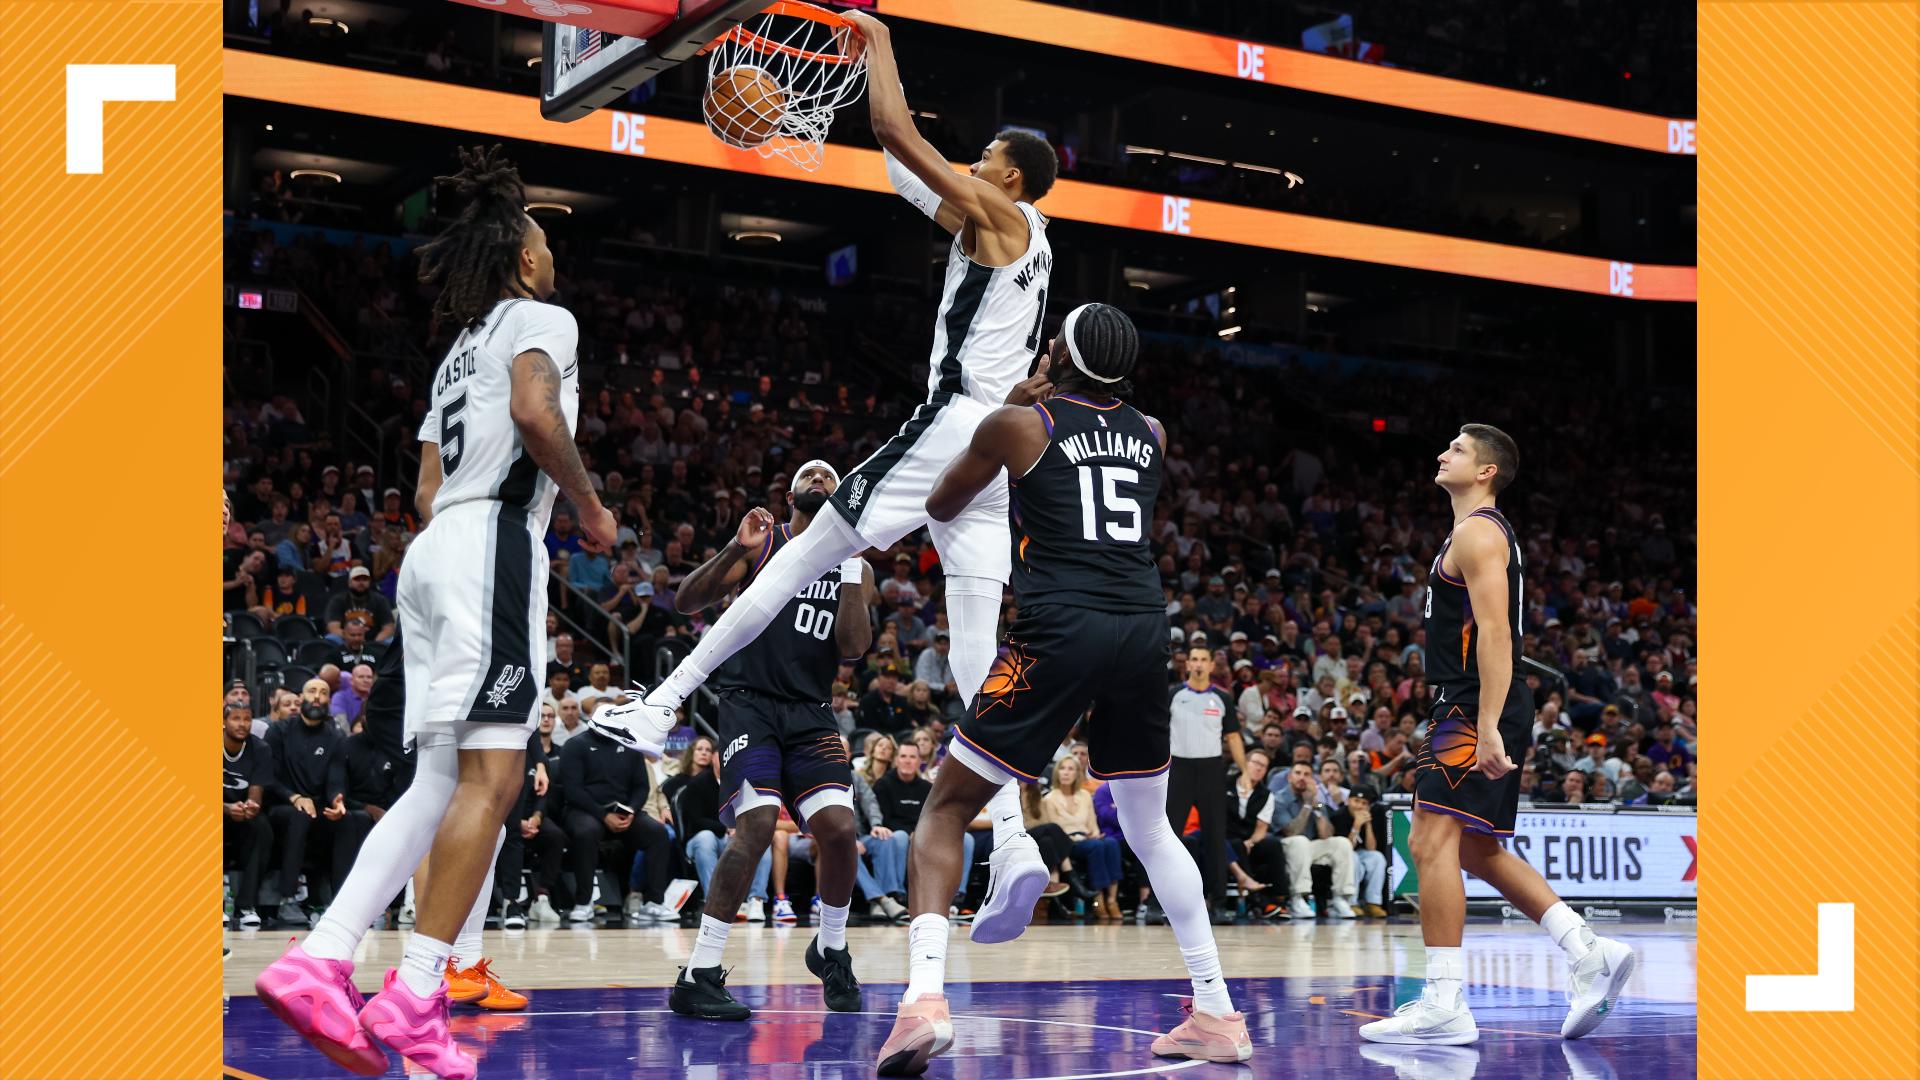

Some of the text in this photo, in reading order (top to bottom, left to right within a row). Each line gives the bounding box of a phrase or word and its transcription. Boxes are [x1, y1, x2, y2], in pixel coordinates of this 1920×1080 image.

[1237, 42, 1265, 81] DE
[611, 111, 646, 155] DE
[1667, 120, 1697, 155] DE
[1162, 195, 1191, 235] DE
[1609, 261, 1633, 297] DE
[1024, 287, 1046, 355] 1
[437, 346, 477, 397] CASTLE
[440, 385, 468, 478] 5
[1058, 430, 1154, 468] WILLIAMS
[1077, 465, 1142, 542] 15
[794, 602, 834, 641] 00
[1521, 817, 1587, 828] CERVEZA
[1544, 835, 1642, 883] EQUIS
